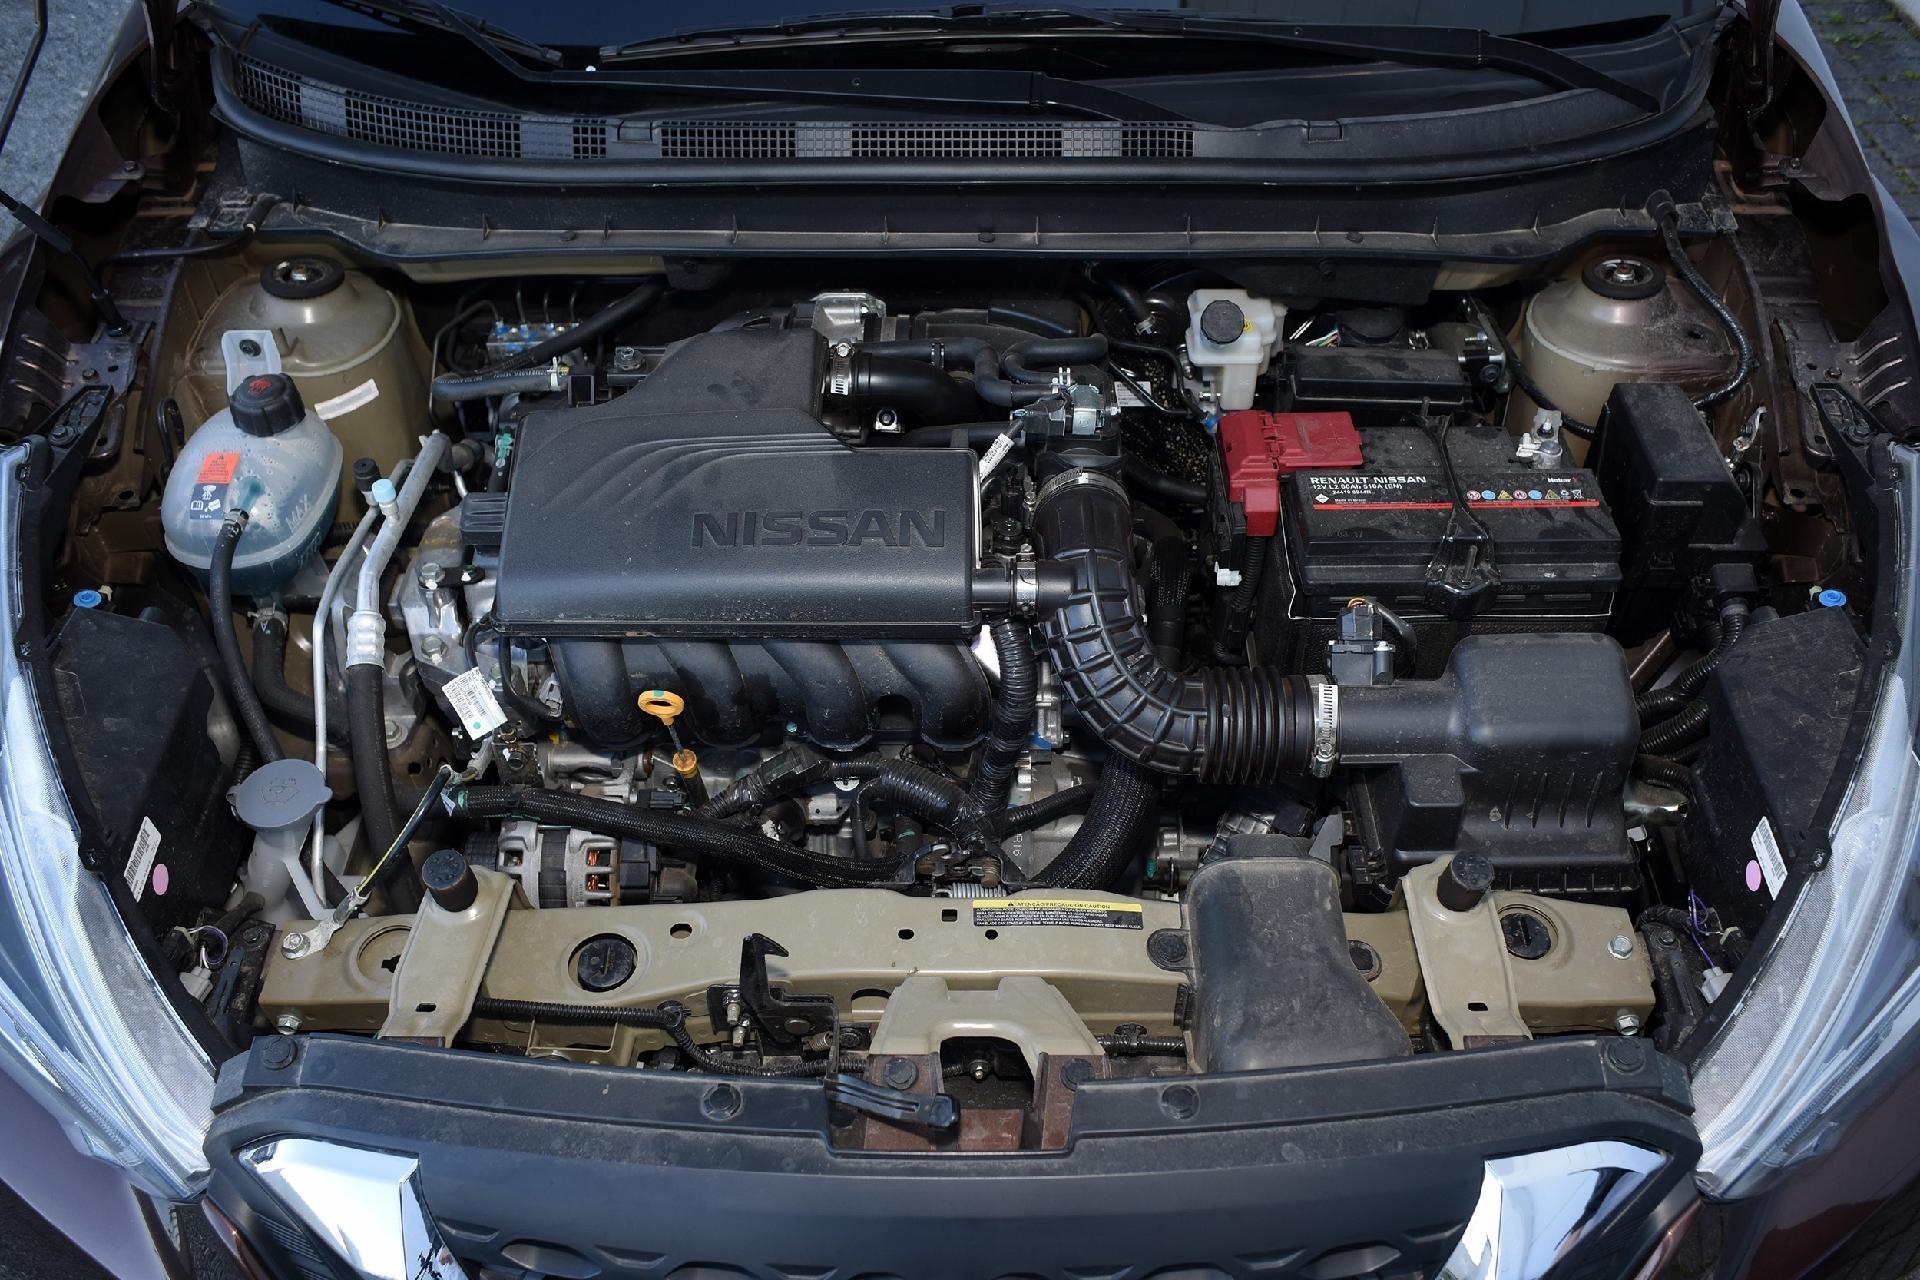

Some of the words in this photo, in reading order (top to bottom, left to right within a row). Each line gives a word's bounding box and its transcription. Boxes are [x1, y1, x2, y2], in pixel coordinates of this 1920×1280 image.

[1310, 476, 1369, 484] RENAULT
[691, 509, 945, 548] NISSAN
[1012, 833, 1023, 857] R16
